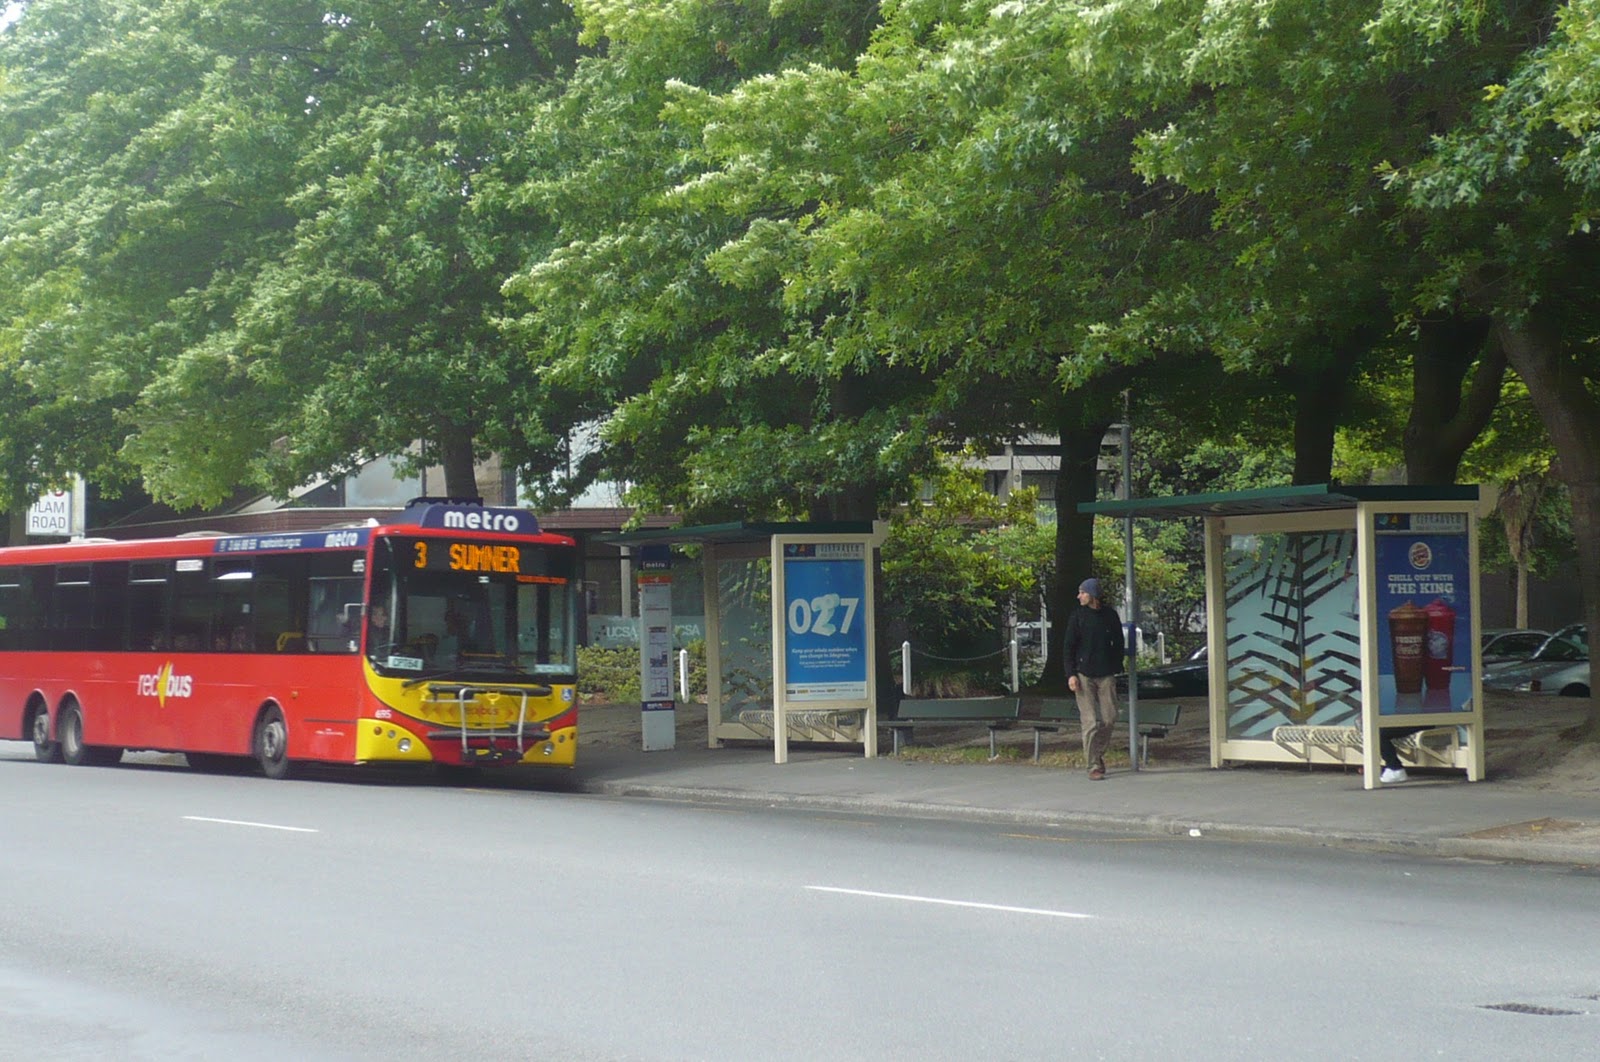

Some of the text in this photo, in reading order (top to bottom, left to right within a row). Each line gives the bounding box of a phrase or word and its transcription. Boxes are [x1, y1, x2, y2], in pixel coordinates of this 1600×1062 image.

[32, 516, 66, 529] ROAD
[443, 510, 519, 532] metro
[324, 531, 358, 548] metro
[414, 542, 520, 573] 3 SUMNER
[1388, 583, 1454, 594] THE KING
[788, 593, 859, 637] 027
[607, 626, 638, 638] UCSA
